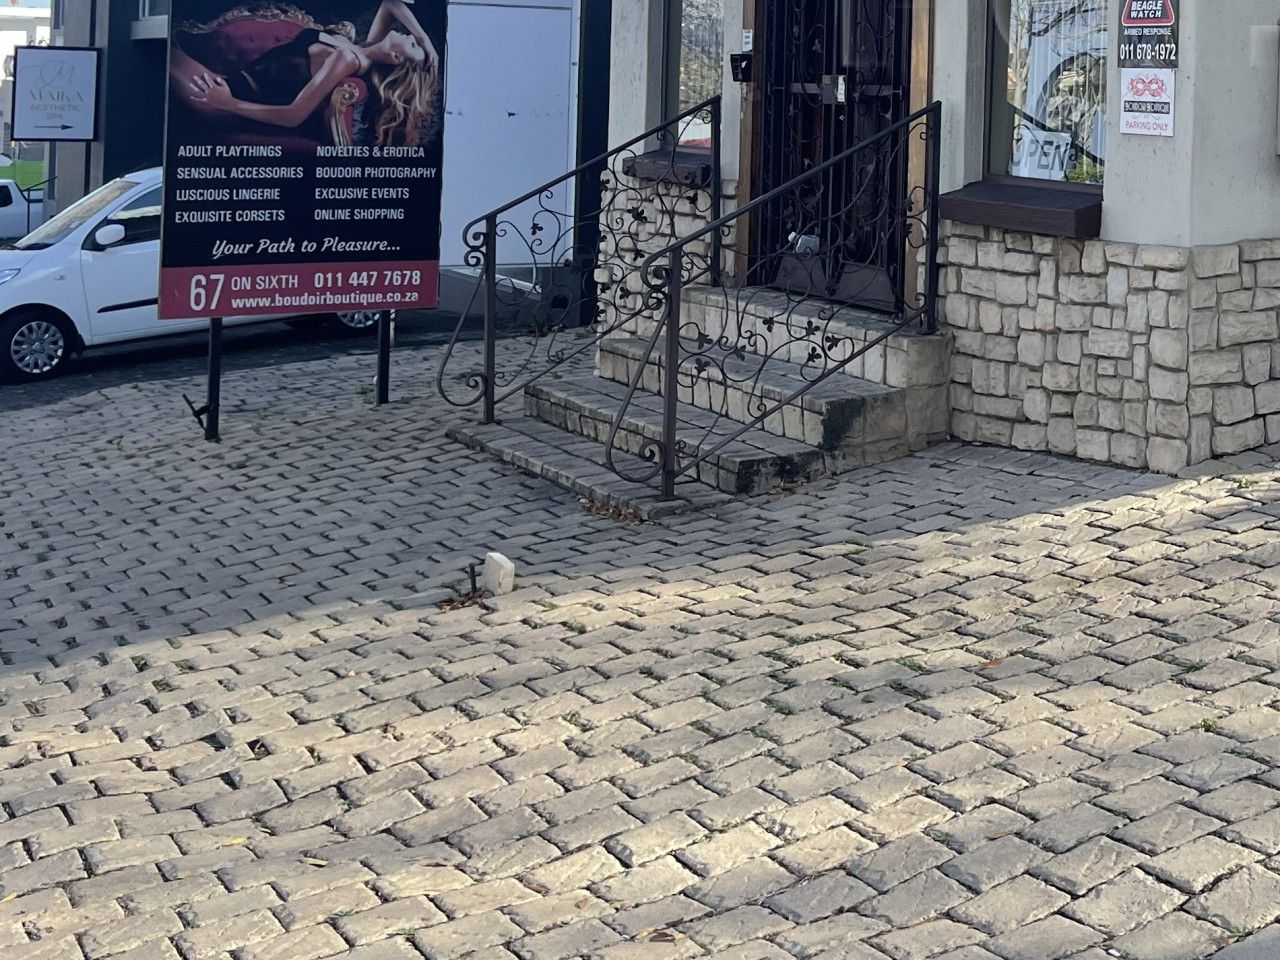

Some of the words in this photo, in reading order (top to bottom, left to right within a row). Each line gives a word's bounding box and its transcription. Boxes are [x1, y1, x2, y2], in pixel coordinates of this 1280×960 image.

[1131, 0, 1163, 11] BEAGLE
[1130, 10, 1162, 19] WATCH
[1124, 28, 1142, 36] ARMED
[1143, 27, 1172, 36] RESPONSE
[1120, 44, 1134, 61] 011
[1136, 44, 1177, 61] 678-1972
[1125, 121, 1150, 131] PARKING
[1152, 122, 1169, 131] ONLY
[178, 146, 213, 157] ADULT
[216, 145, 282, 157] PLAYTHINGS
[316, 146, 370, 157] NOVELTIES
[372, 147, 381, 157] &
[383, 146, 425, 158] EROTICA
[1011, 138, 1069, 171] OPEN
[177, 167, 227, 179] SENSUAL
[230, 167, 304, 178] ACCESSORIES
[316, 167, 362, 178] BOUDOIR
[364, 167, 436, 178] PHOTOGRAPHY
[176, 189, 230, 201] LUSCIOUS
[233, 188, 280, 200] LINGERIE
[315, 188, 369, 199] EXCLUSIVE
[371, 188, 410, 199] EVENTS
[175, 211, 232, 223] EXQUISITE
[235, 210, 285, 221] CORSETS
[314, 209, 351, 220] ONLINE
[353, 209, 404, 220] SHOPPING
[212, 240, 254, 259] Your
[256, 238, 295, 253] Path
[301, 240, 317, 252] to
[321, 237, 400, 252] Pleasure...
[190, 274, 225, 311] 67
[231, 276, 252, 290] ON
[255, 275, 299, 290] SIXTH
[314, 272, 342, 288] 011
[348, 271, 377, 287] 447
[383, 270, 421, 286] 7678
[231, 290, 419, 309] www.boudoirboutique.co.za
